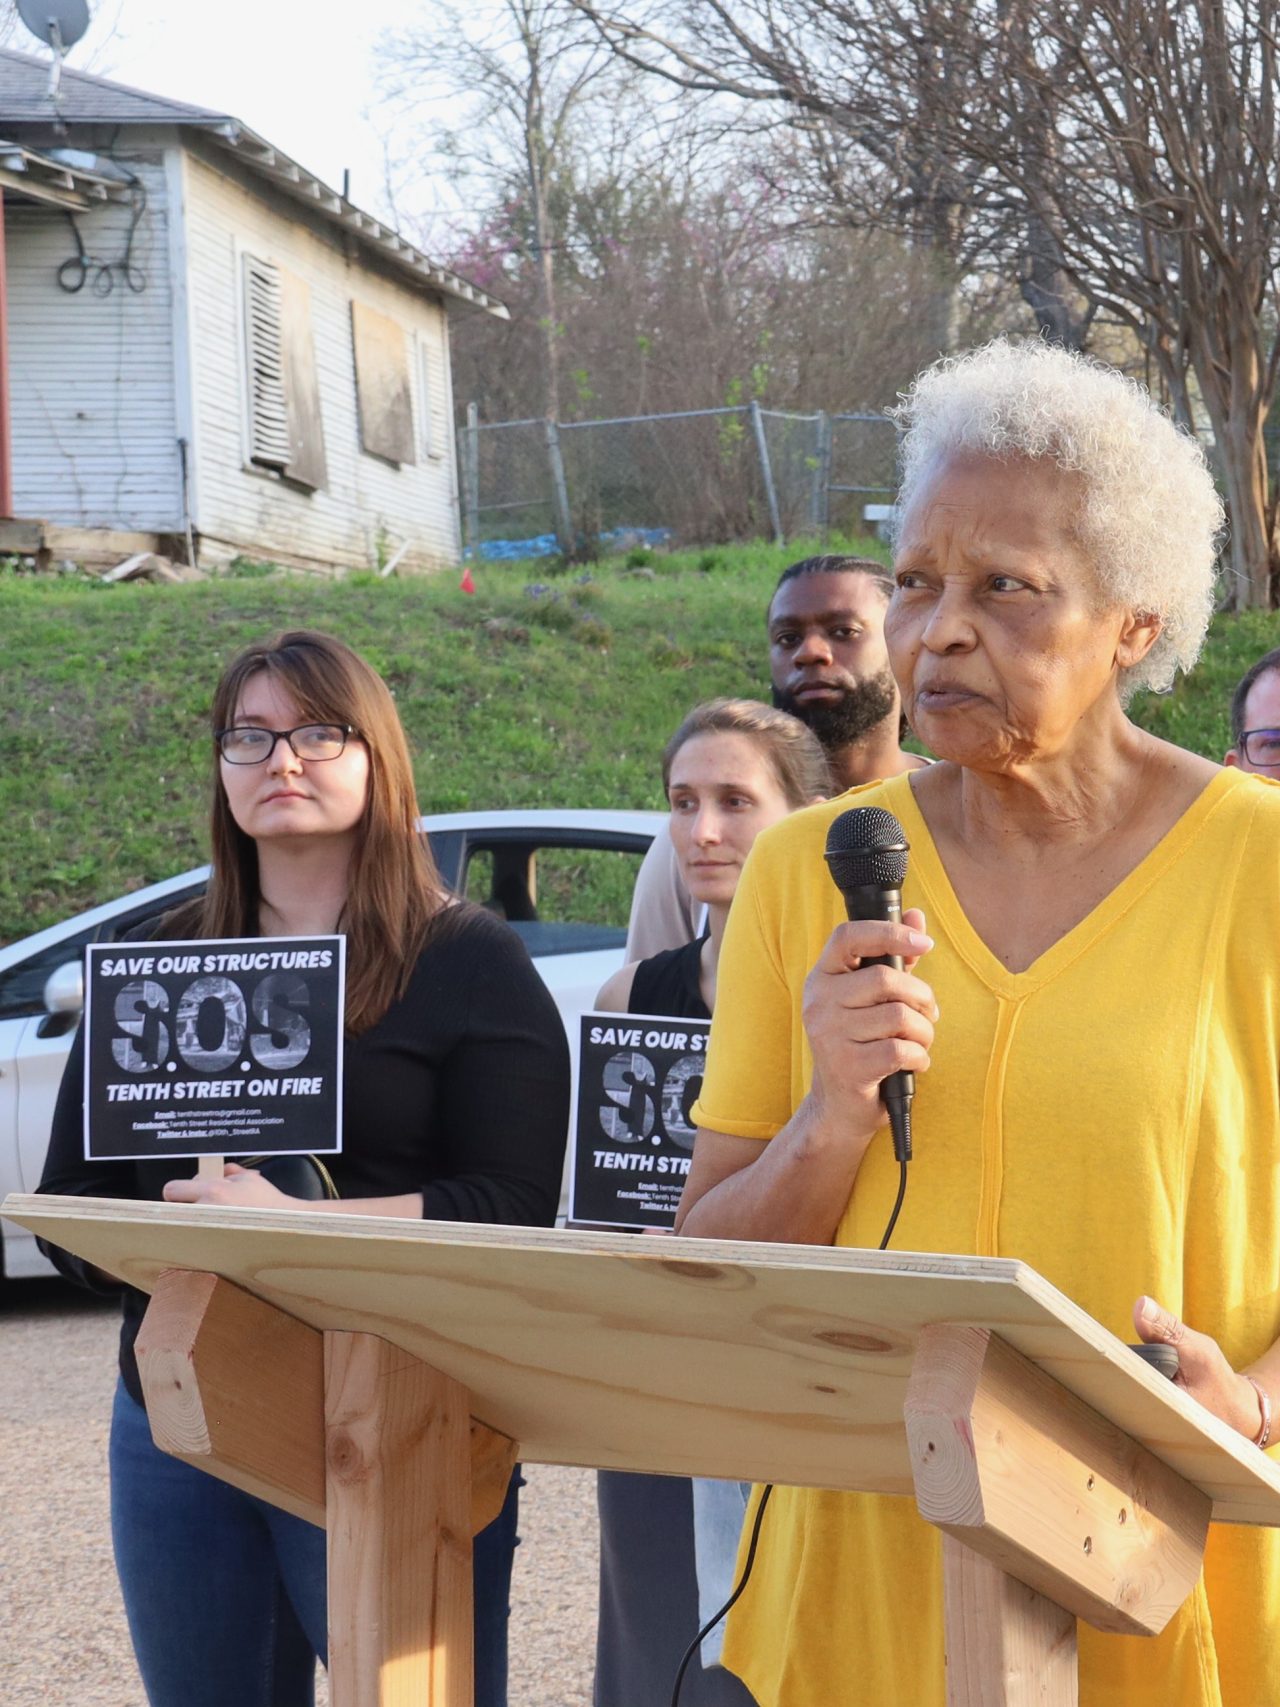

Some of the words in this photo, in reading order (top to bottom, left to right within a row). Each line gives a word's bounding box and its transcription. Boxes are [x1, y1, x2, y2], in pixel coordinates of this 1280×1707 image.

[100, 957, 154, 976] SAVE
[157, 955, 202, 974] OUR
[203, 950, 333, 972] STRUCTURES
[590, 1027, 643, 1047] SAVE
[644, 1030, 689, 1050] OUR
[690, 1034, 711, 1051] ST
[106, 1082, 171, 1101] TENTH
[173, 1079, 245, 1099] STREET
[247, 1078, 278, 1097] ON
[281, 1077, 323, 1096] FIRE
[599, 1052, 706, 1149] S.O
[593, 1151, 655, 1172] TENTH
[656, 1155, 692, 1175] STR
